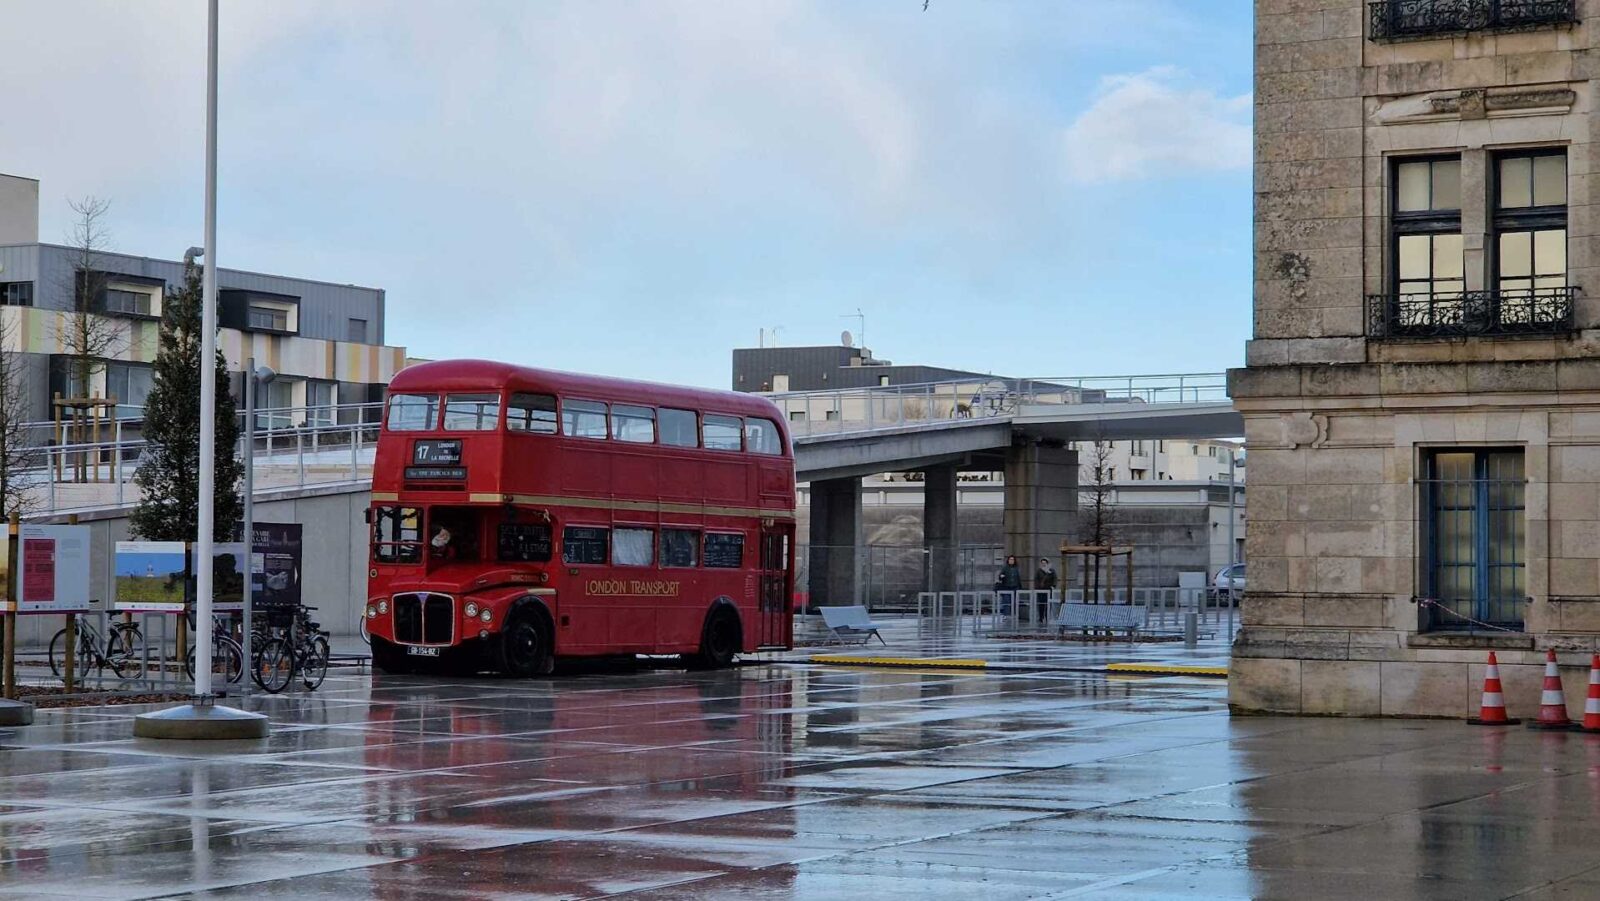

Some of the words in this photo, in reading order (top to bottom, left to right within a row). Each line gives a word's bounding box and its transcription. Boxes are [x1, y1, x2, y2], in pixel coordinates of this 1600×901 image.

[417, 445, 430, 460] 17
[585, 580, 626, 596] LONDON
[630, 580, 680, 596] TRANSPORT
